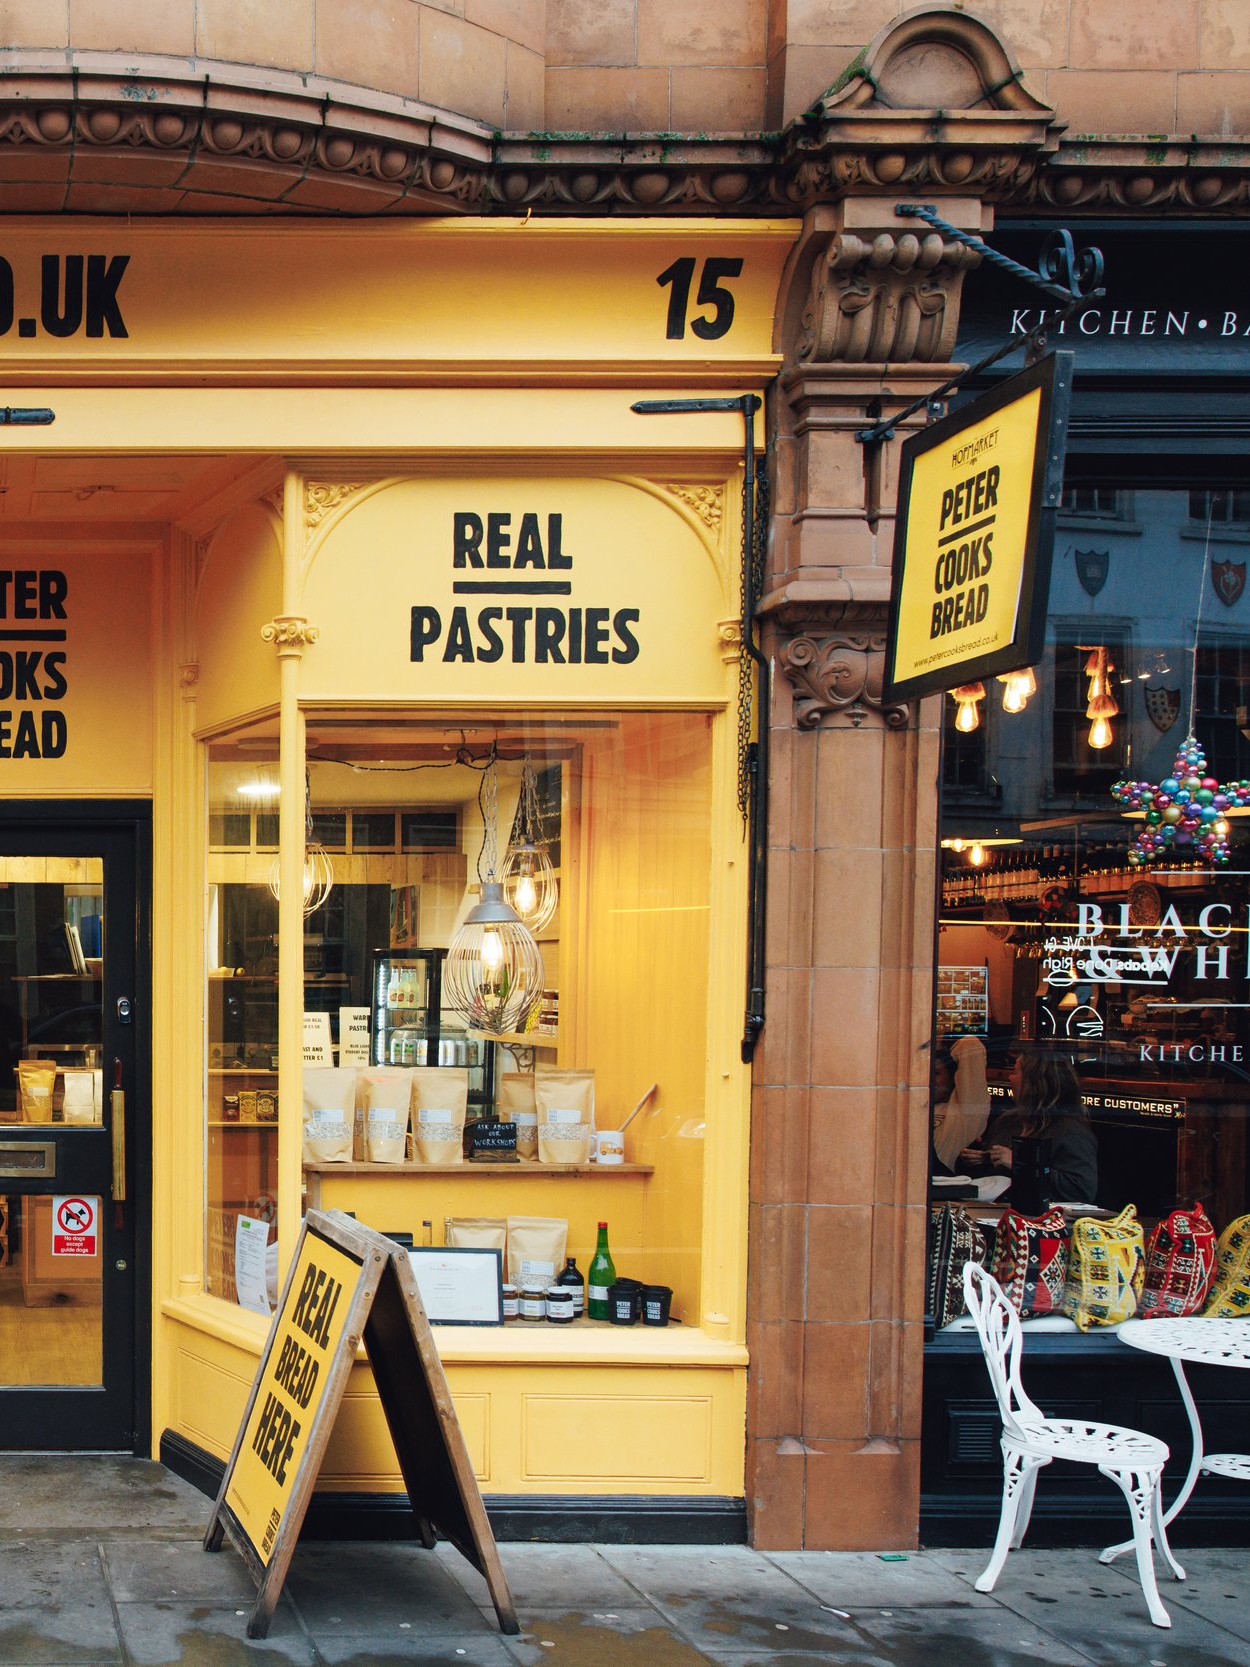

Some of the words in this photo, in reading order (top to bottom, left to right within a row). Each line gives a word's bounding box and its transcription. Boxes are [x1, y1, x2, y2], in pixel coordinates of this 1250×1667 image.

[655, 257, 744, 340] 15
[939, 464, 1000, 532] PETER
[452, 512, 573, 570] REAL
[934, 531, 994, 595] COOKS
[410, 605, 640, 665] PASTRIES
[930, 583, 990, 640] BREAD
[1076, 903, 1250, 938] BLAC
[1139, 1045, 1244, 1062] KITCHE
[474, 1138, 516, 1147] WORKSHOPS
[291, 1261, 342, 1351] REAL
[274, 1334, 320, 1411] BREAD
[252, 1391, 302, 1488] HERE
